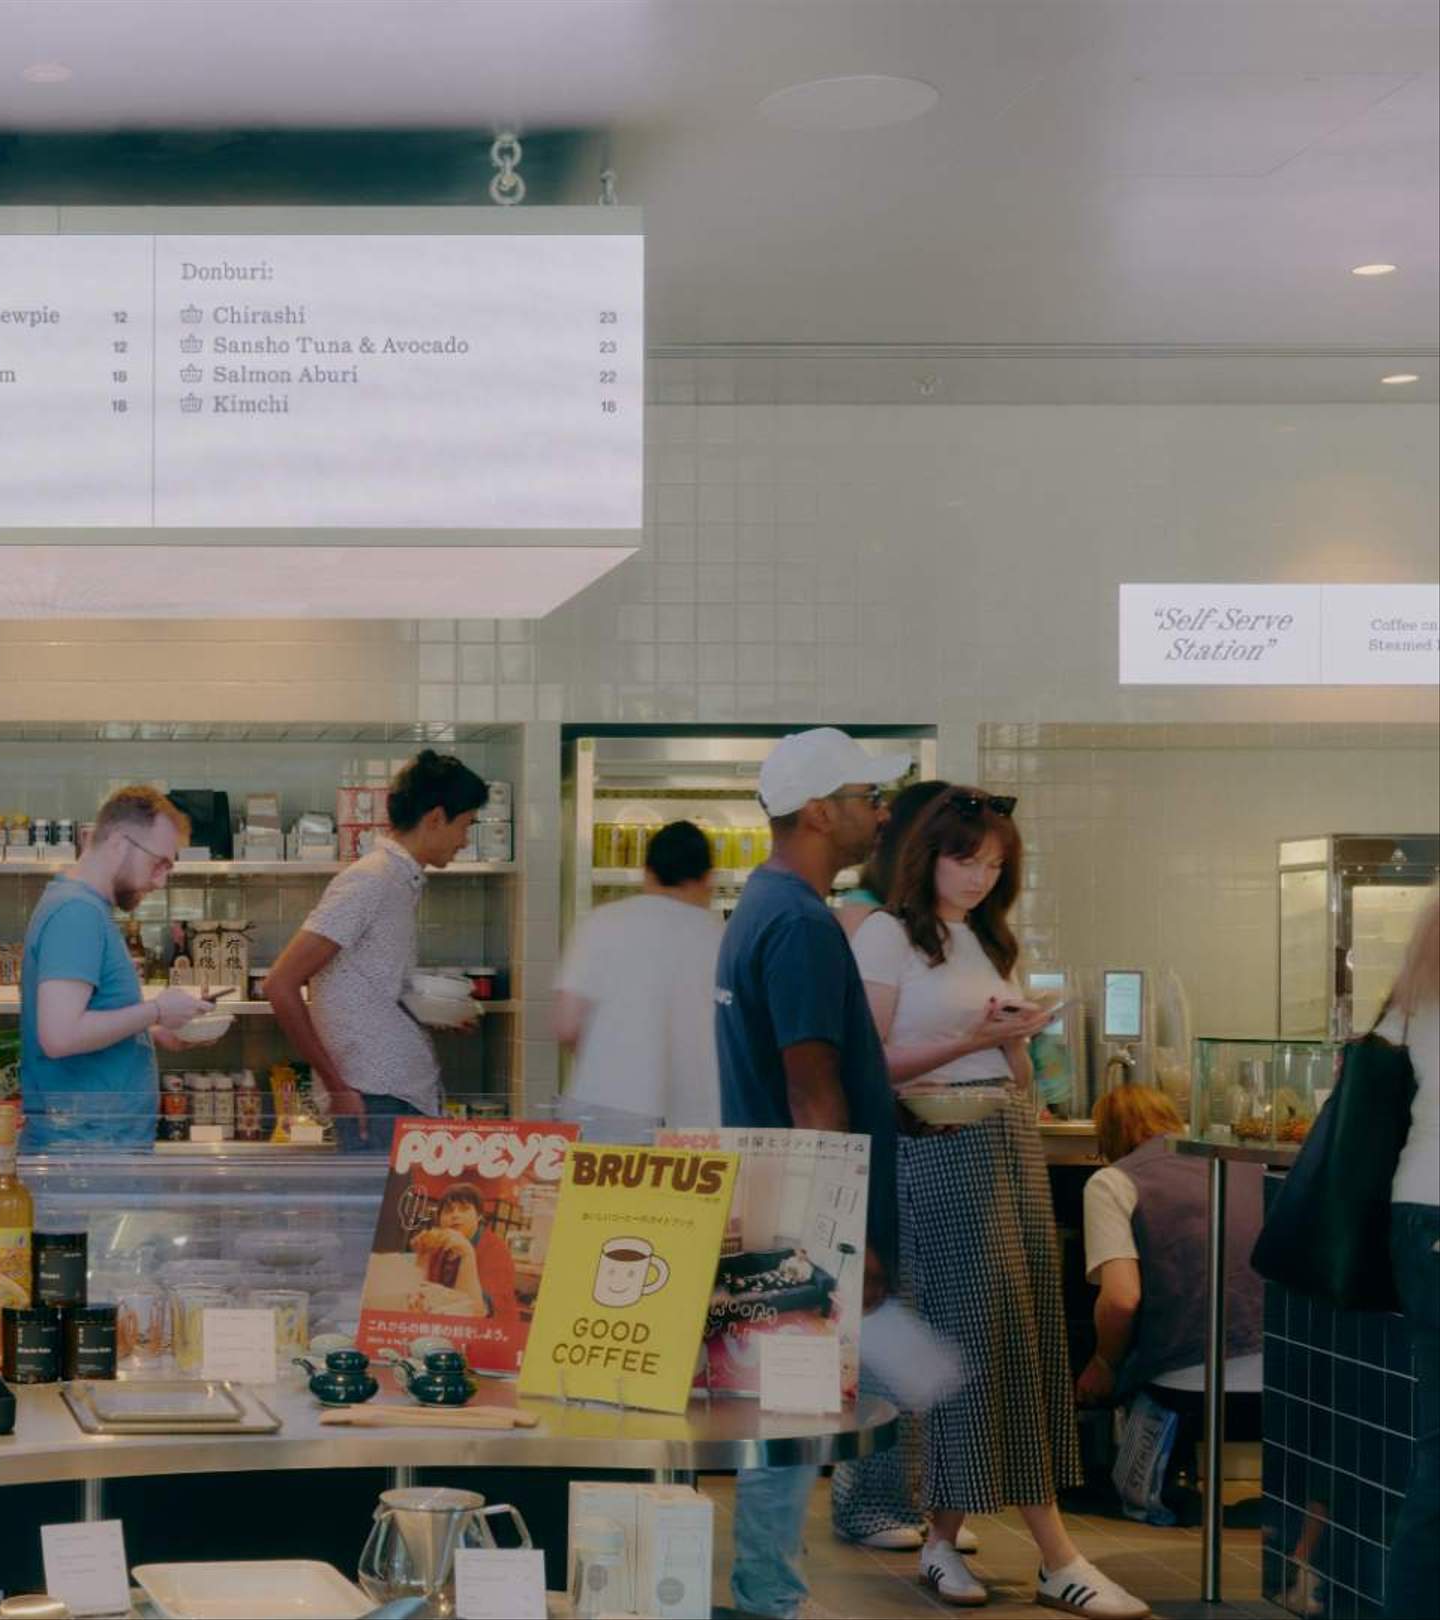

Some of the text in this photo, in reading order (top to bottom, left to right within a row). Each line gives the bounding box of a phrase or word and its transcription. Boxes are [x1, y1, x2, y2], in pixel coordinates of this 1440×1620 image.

[181, 261, 273, 281] Donburi:
[112, 311, 128, 323] 12
[213, 306, 617, 325] Chirashi 23
[112, 341, 128, 353] 12
[213, 336, 617, 354] Sansho Tuna & Avocado 23
[213, 365, 617, 384] Salmon Aburi 22
[213, 394, 290, 413] Kimchi
[1370, 617, 1418, 632] Coffee
[1367, 638, 1433, 652] Steamed
[395, 1130, 570, 1181] POPEYE
[572, 1151, 730, 1195] BRUTUS
[572, 1317, 651, 1344] GOOD
[551, 1343, 661, 1375] COFFEE
